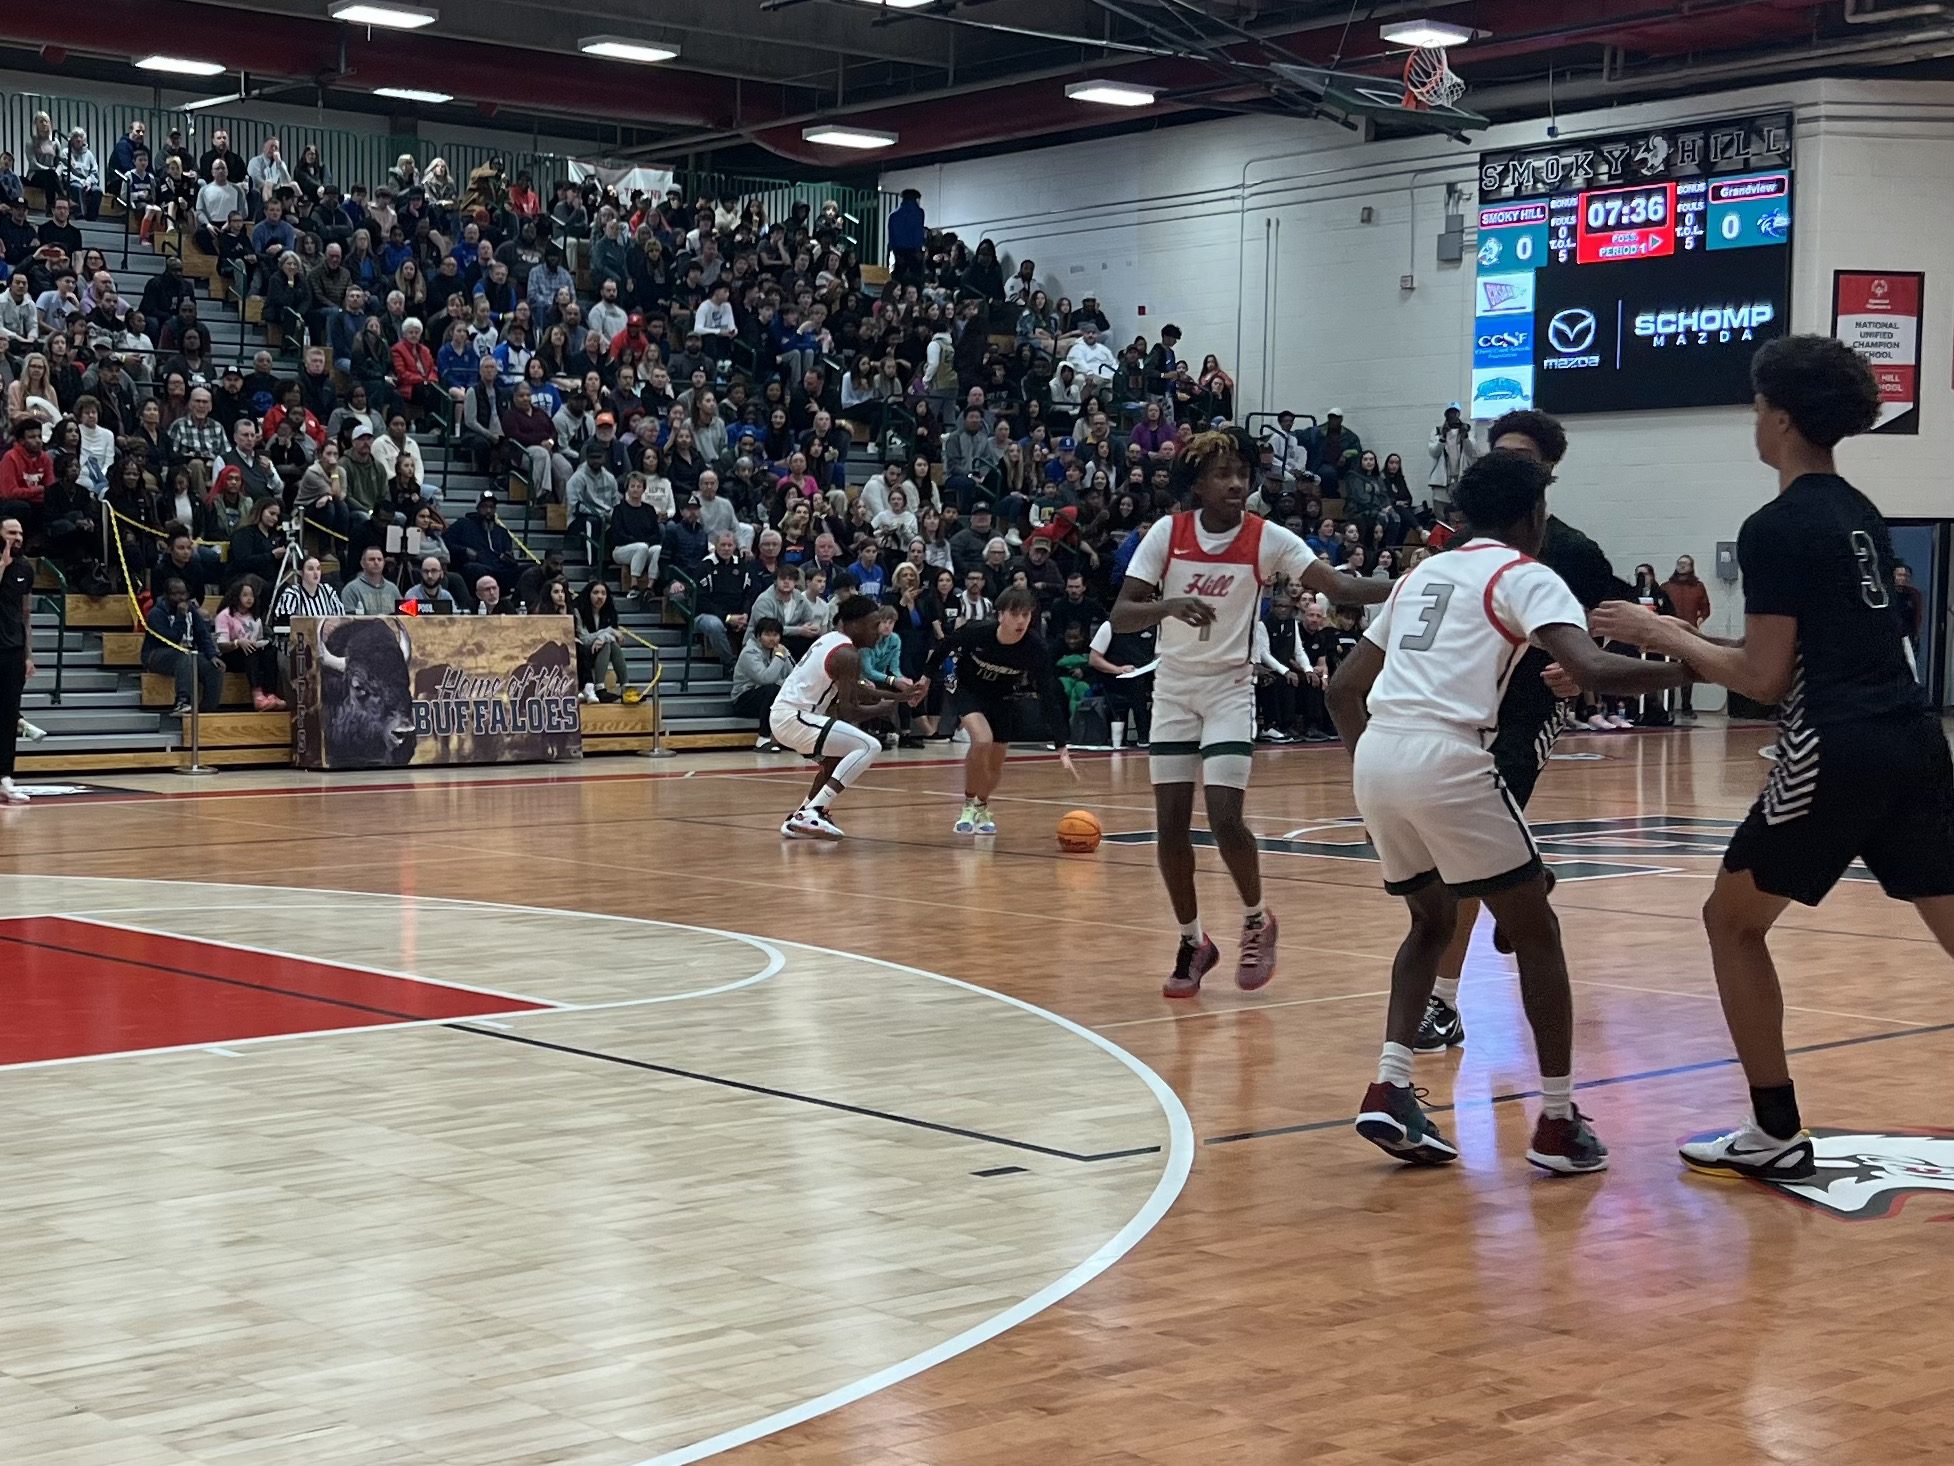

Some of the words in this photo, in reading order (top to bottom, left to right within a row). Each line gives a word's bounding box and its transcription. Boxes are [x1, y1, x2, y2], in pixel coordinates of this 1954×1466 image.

[1482, 146, 1630, 190] SMOKY
[1677, 127, 1784, 166] HILL
[1677, 182, 1706, 195] BONUS
[1720, 183, 1777, 198] Grandview
[1588, 195, 1665, 228] 07:36
[1677, 202, 1705, 213] FOULS
[1481, 210, 1519, 225] SMOKY
[1520, 208, 1544, 221] HILL
[1685, 213, 1695, 226] 0
[1722, 214, 1739, 239] 0
[1516, 236, 1532, 259] 0
[1599, 245, 1638, 257] PERIOD
[1639, 243, 1647, 254] 1
[1634, 304, 1774, 336] SCHOMP
[1855, 321, 1900, 330] NATIONAL
[1652, 329, 1753, 347] MAZDA
[1860, 331, 1894, 340] UNIFIED
[1853, 341, 1900, 349] CHAMPION
[1864, 351, 1893, 359] CHOOL
[1184, 573, 1234, 597] Hill
[1399, 583, 1455, 651] 3
[434, 666, 504, 700] Home
[508, 665, 534, 700] of
[534, 665, 575, 698] the
[412, 696, 579, 736] BUFFALOES
